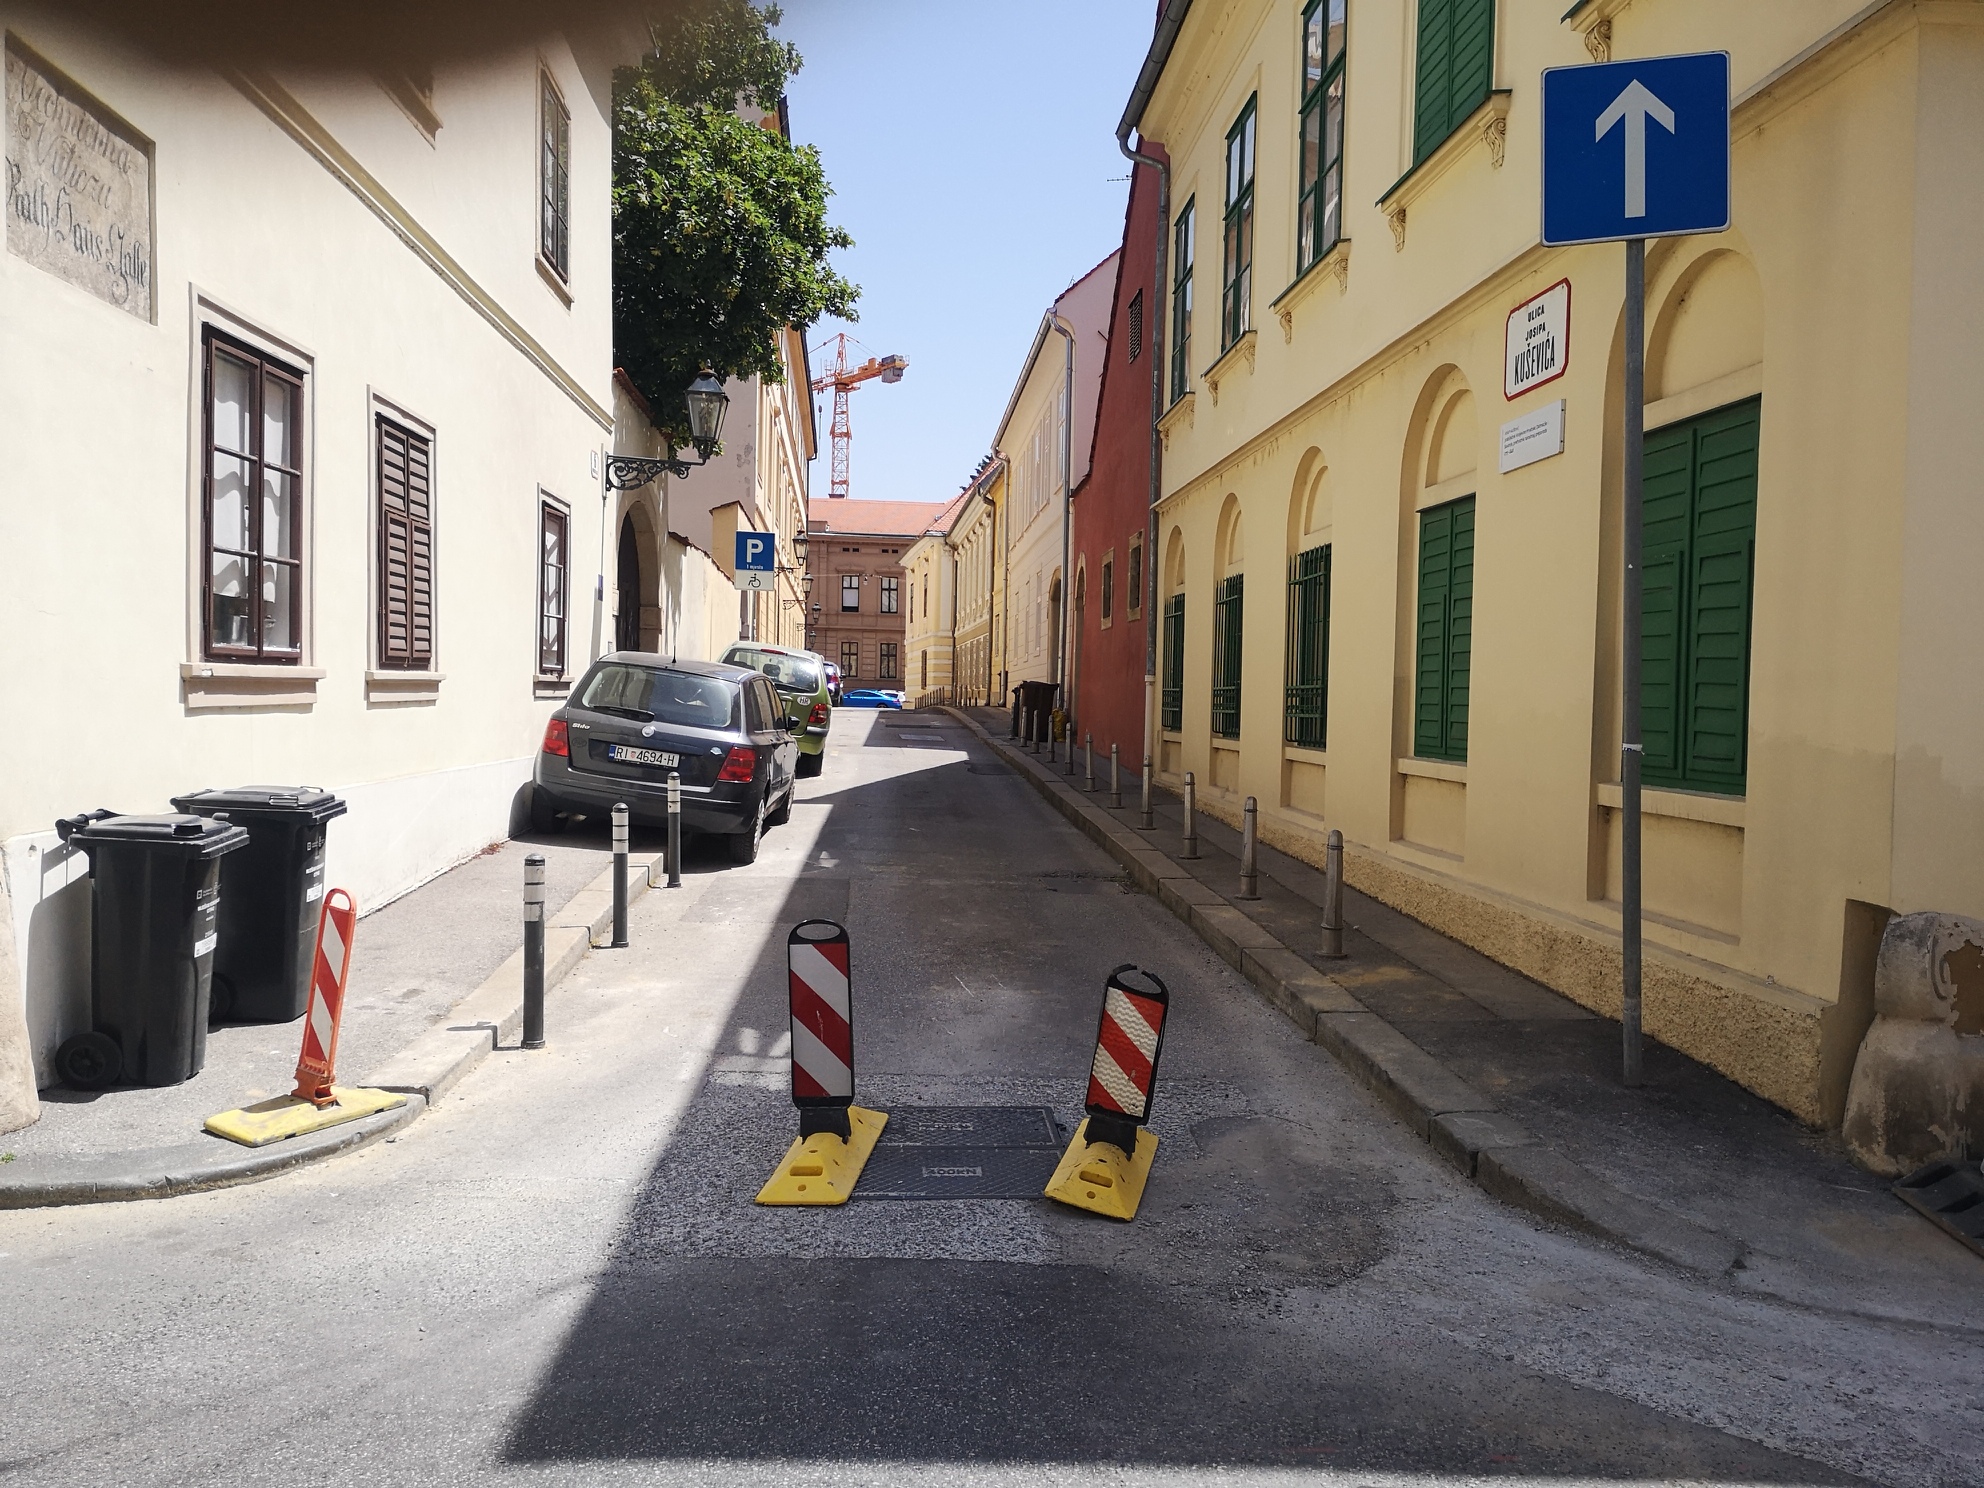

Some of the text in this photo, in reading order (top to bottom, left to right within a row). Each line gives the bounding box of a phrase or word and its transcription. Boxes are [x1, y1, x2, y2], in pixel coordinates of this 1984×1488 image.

[1527, 304, 1545, 323] ULICA
[1525, 322, 1546, 342] JOSIPA
[1514, 331, 1555, 386] KUŠEVIĆA
[746, 538, 764, 563] P
[615, 746, 675, 766] RI 4694-H
